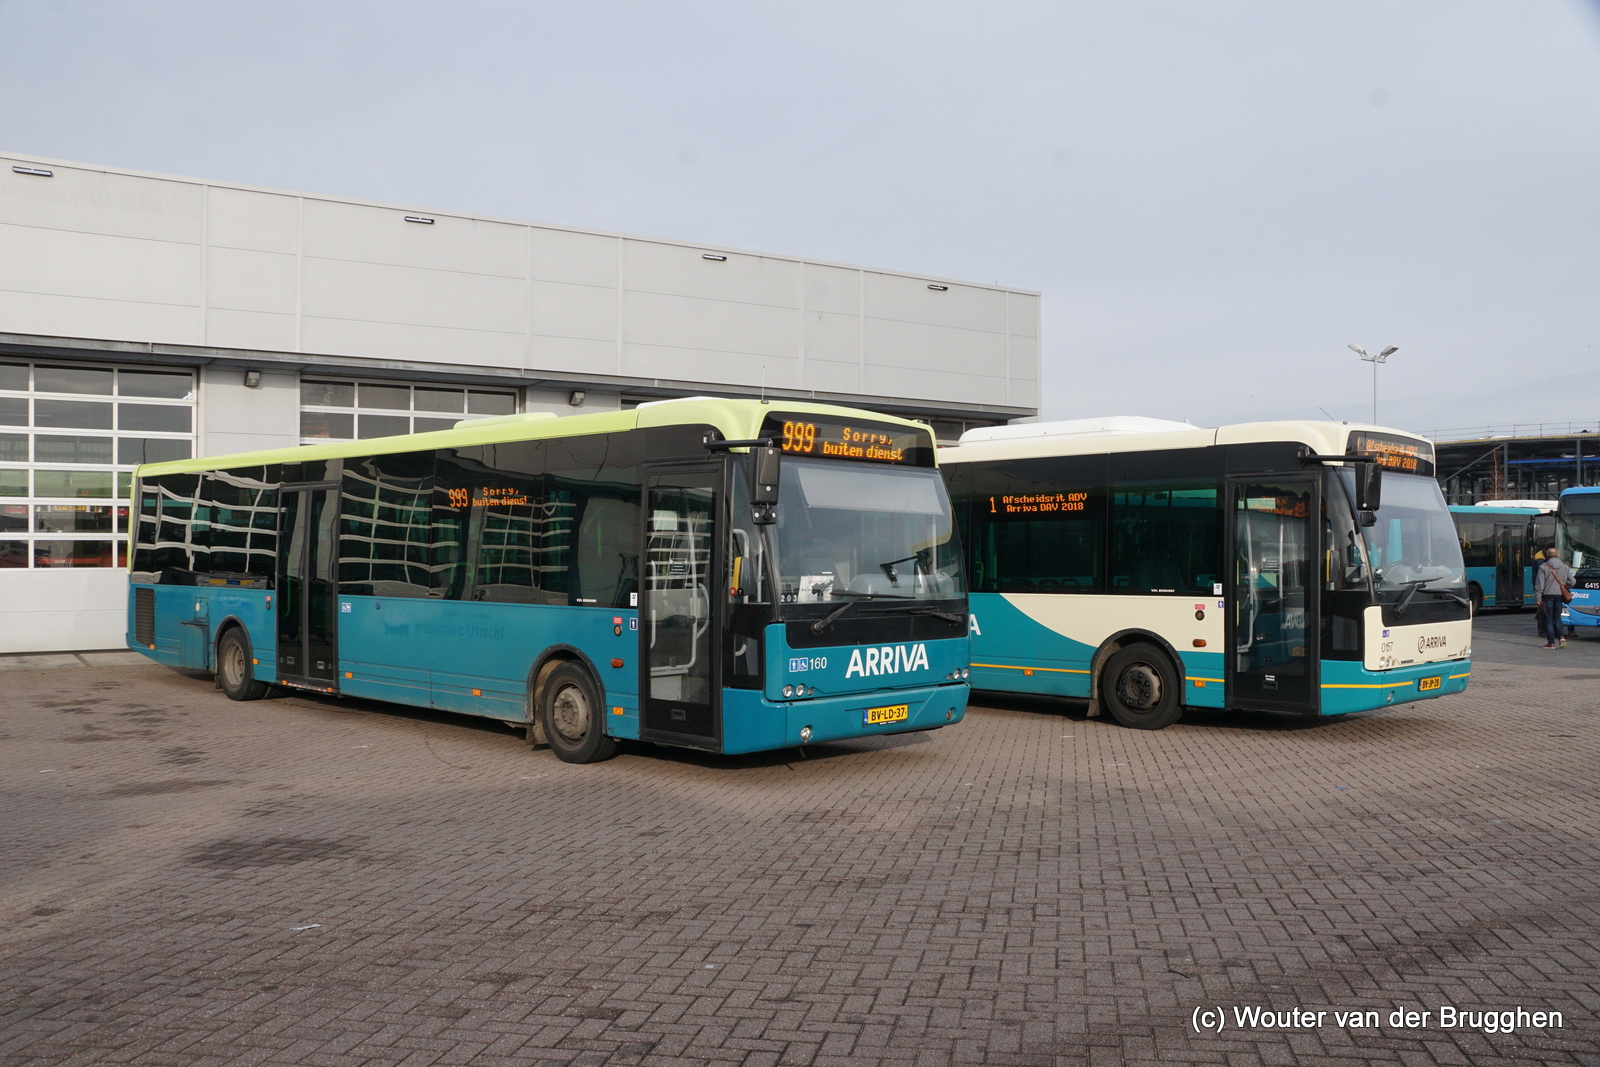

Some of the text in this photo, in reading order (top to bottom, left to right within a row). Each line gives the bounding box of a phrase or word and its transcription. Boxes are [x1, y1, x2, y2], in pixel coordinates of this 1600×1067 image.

[781, 421, 815, 452] 999
[842, 427, 892, 446] Sorry,
[823, 441, 903, 461] buiten dienst
[1402, 457, 1418, 469] 2018
[448, 488, 469, 507] 999
[482, 487, 519, 496] Sorry,
[1002, 492, 1088, 504] Afscheidsrit ADV
[472, 497, 500, 507] buiten
[989, 496, 997, 513] 1
[1006, 502, 1084, 512] Arriva DAV 2018
[1425, 636, 1447, 649] ARRIVA
[809, 657, 827, 670] 160
[845, 643, 930, 678] ARRIVA
[871, 707, 905, 721] BV-LD-37
